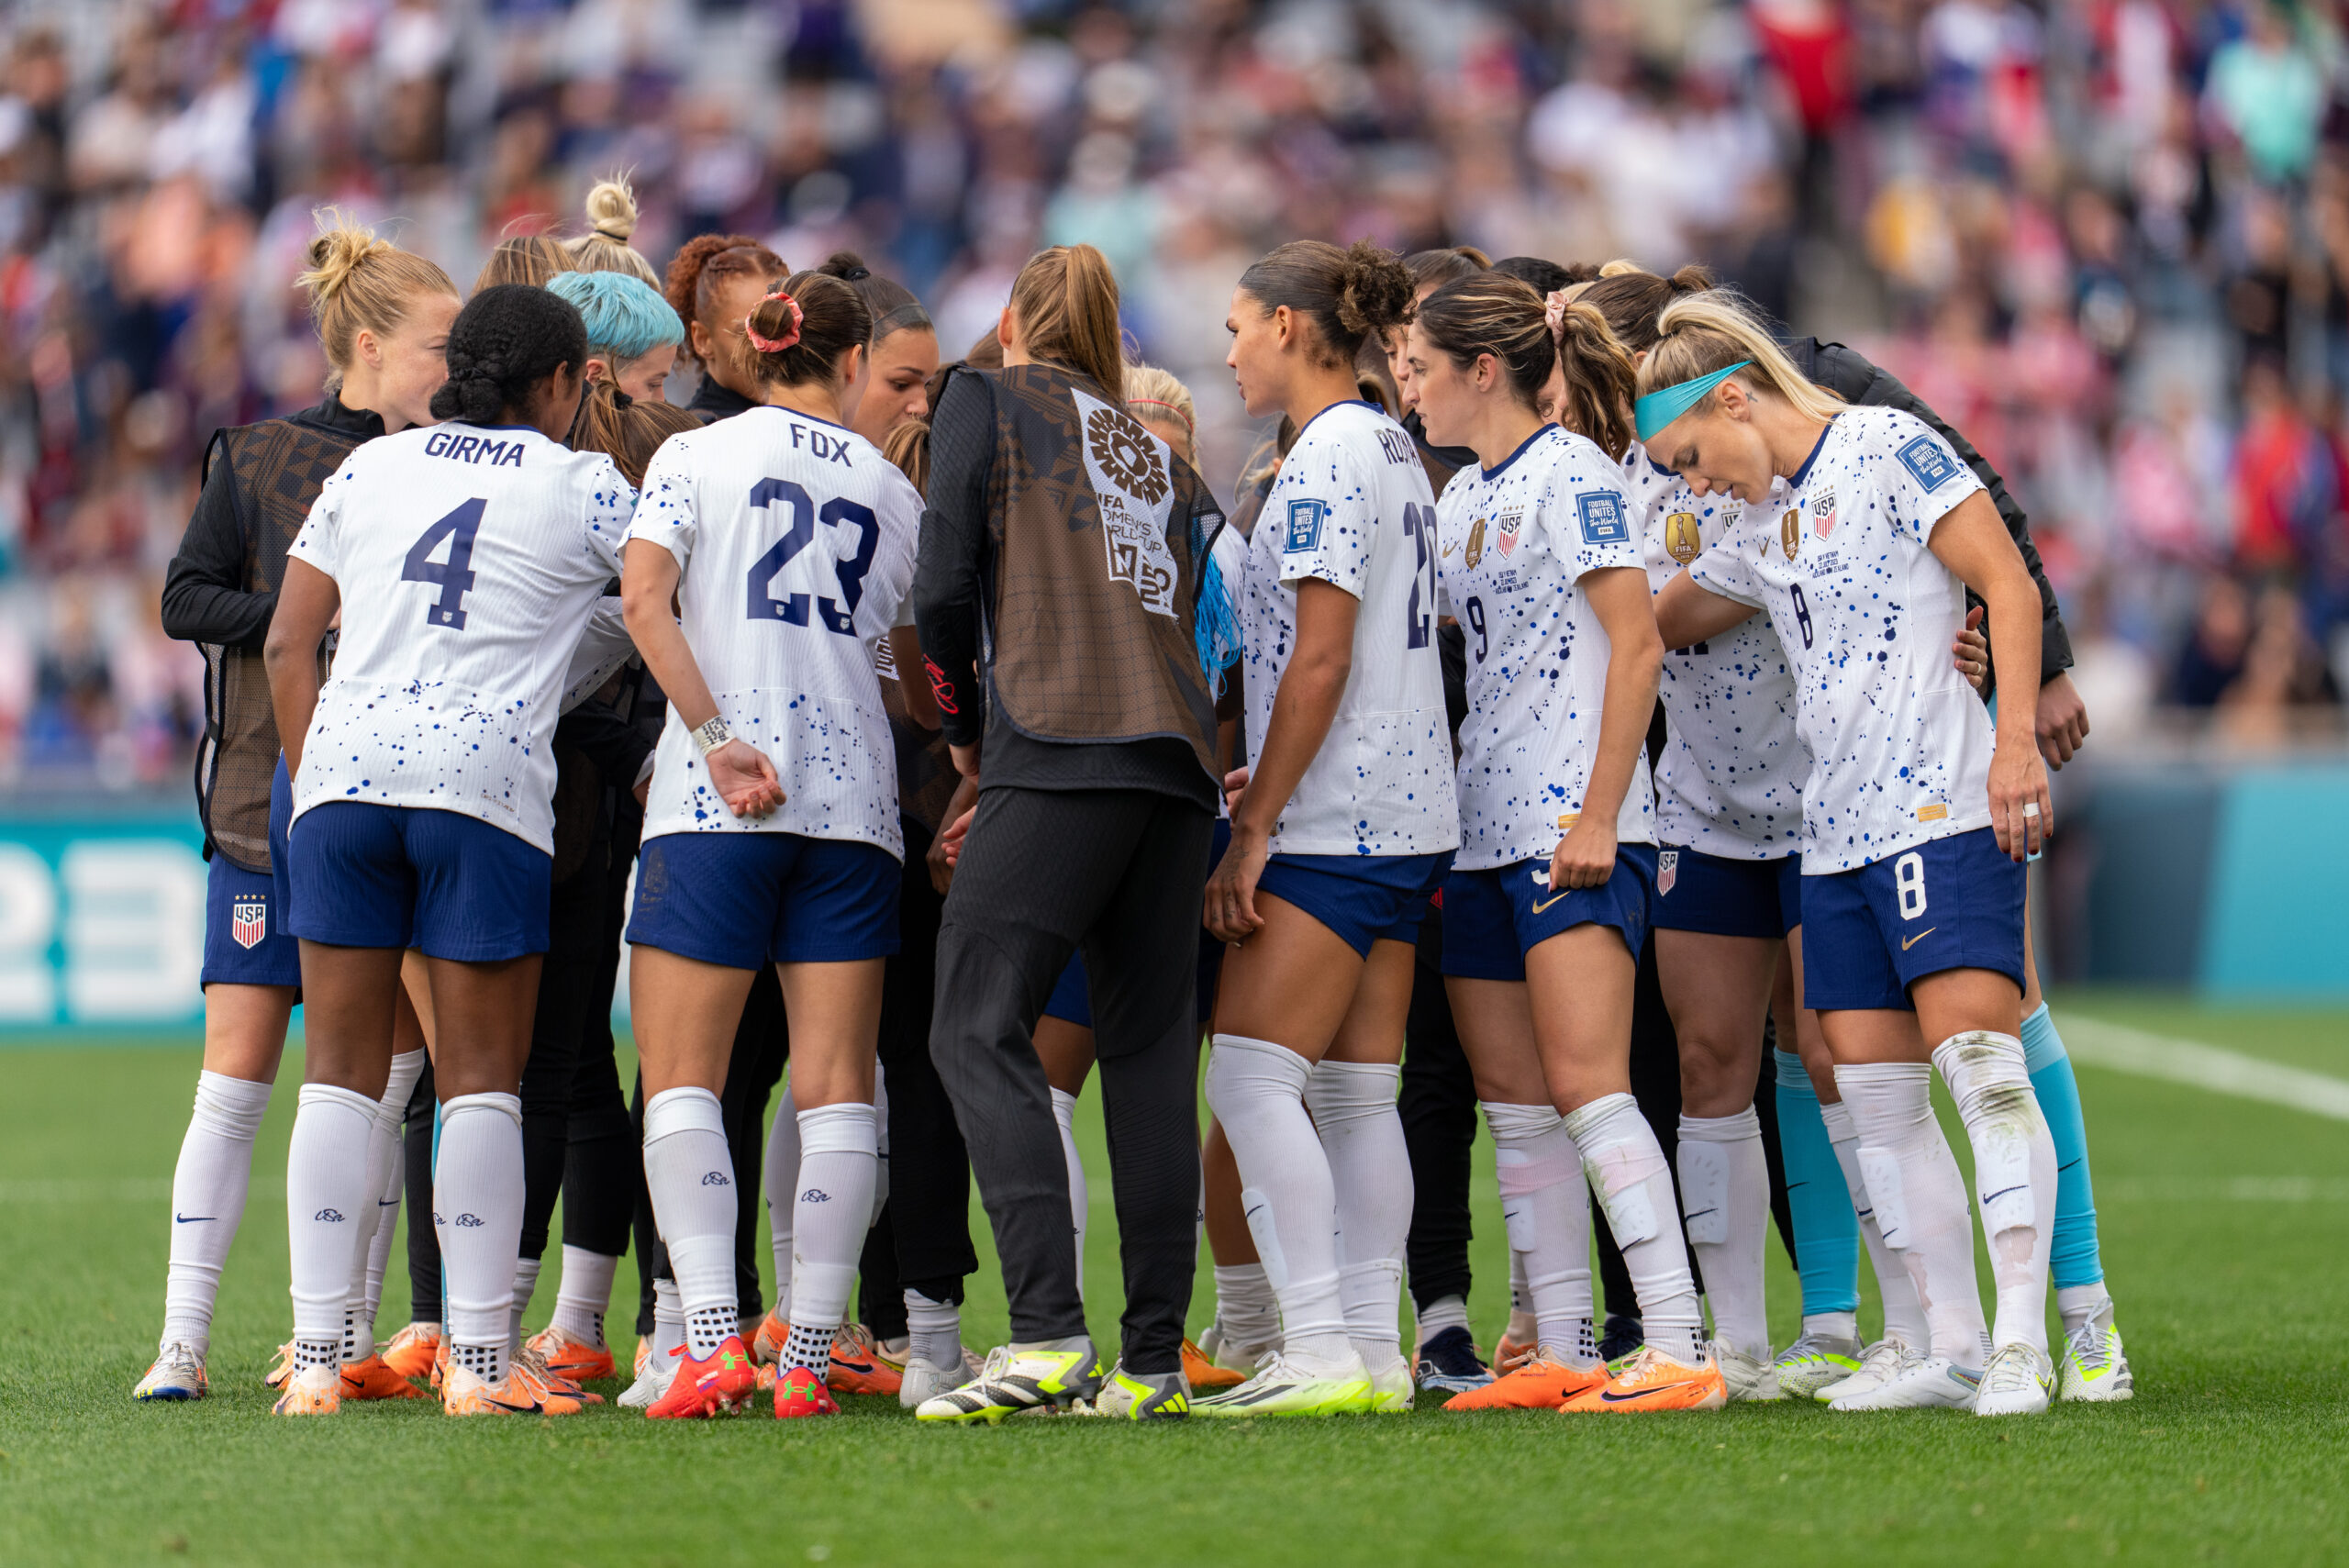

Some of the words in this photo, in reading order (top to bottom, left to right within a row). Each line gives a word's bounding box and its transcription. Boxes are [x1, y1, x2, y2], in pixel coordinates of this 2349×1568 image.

[425, 432, 526, 468] GIRMA
[789, 423, 852, 468] FOX
[1097, 492, 1125, 510] IFA
[1587, 499, 1614, 508] FOOTBALL
[1588, 506, 1617, 518] UNITES
[1814, 496, 1835, 517] USA
[1102, 508, 1152, 537] OMEN'S
[1501, 516, 1521, 534] USA
[400, 496, 488, 631] 4
[747, 476, 880, 637] 23
[1675, 545, 1692, 553] FIFA
[1466, 595, 1488, 664] 9
[1789, 582, 1814, 651] 8
[1895, 851, 1927, 921] 8
[236, 906, 264, 923] USA
